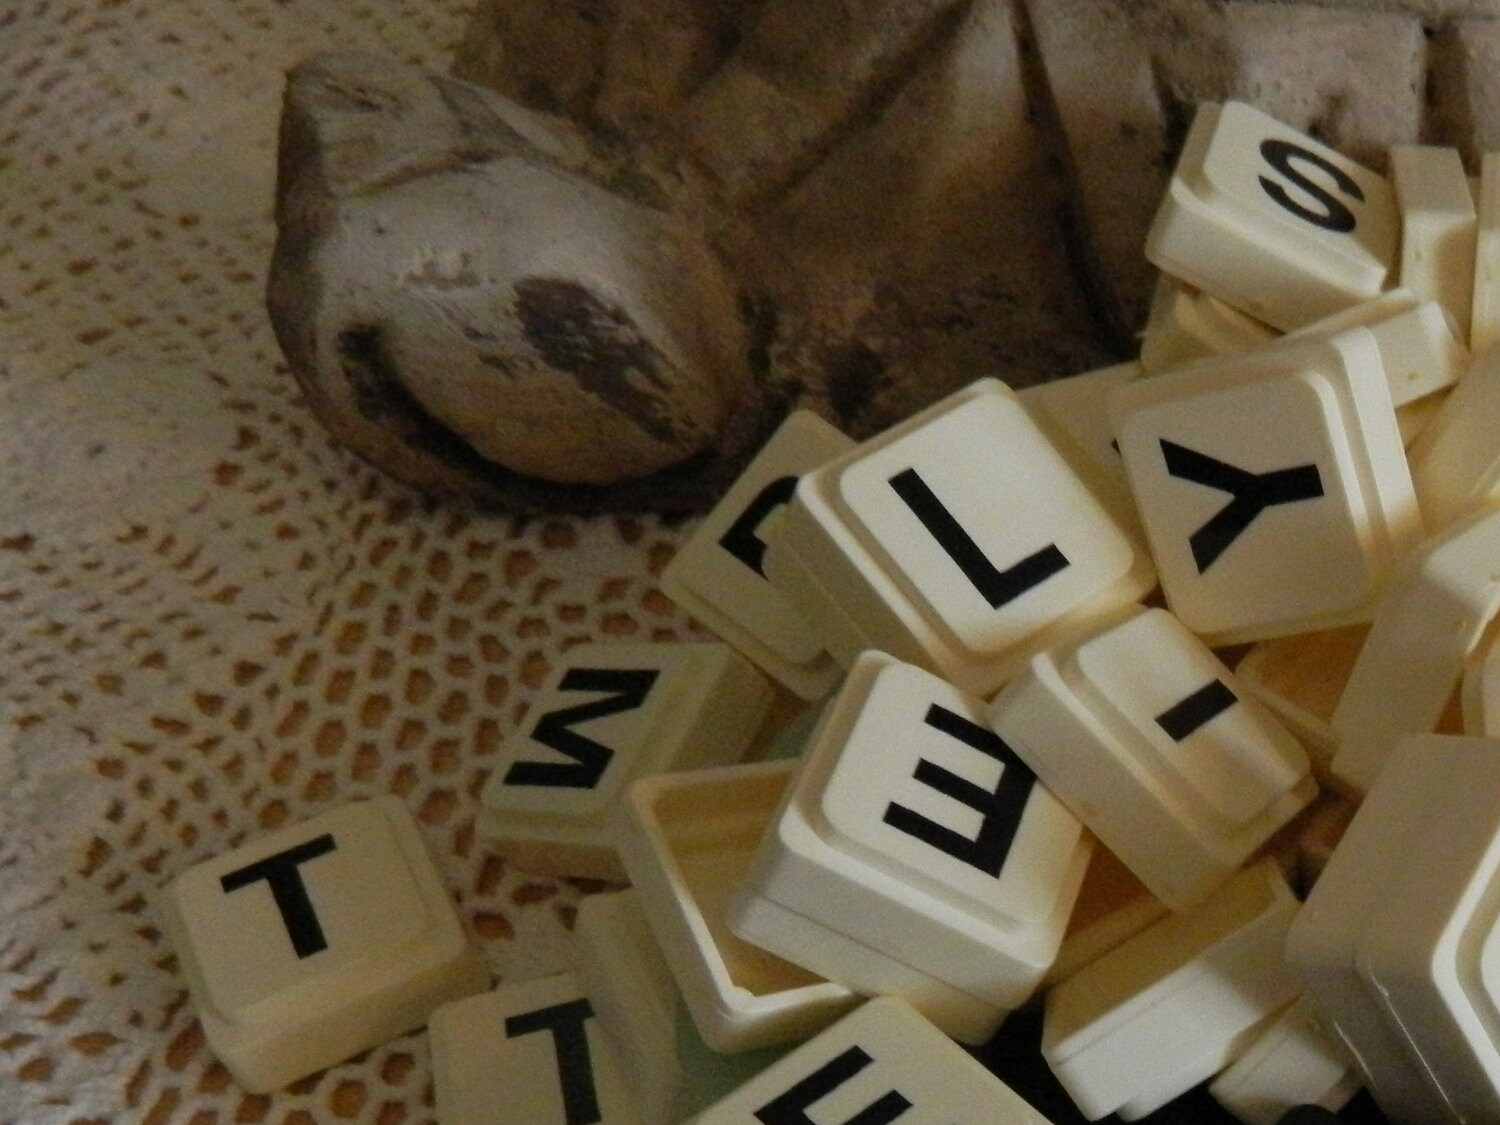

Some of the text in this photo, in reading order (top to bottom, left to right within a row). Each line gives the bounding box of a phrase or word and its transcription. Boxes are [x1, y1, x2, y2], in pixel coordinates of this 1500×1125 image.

[1255, 135, 1370, 237] S
[887, 467, 1072, 612] L
[1157, 436, 1327, 576] Y
[880, 702, 1038, 881] E
[219, 832, 339, 962] T
